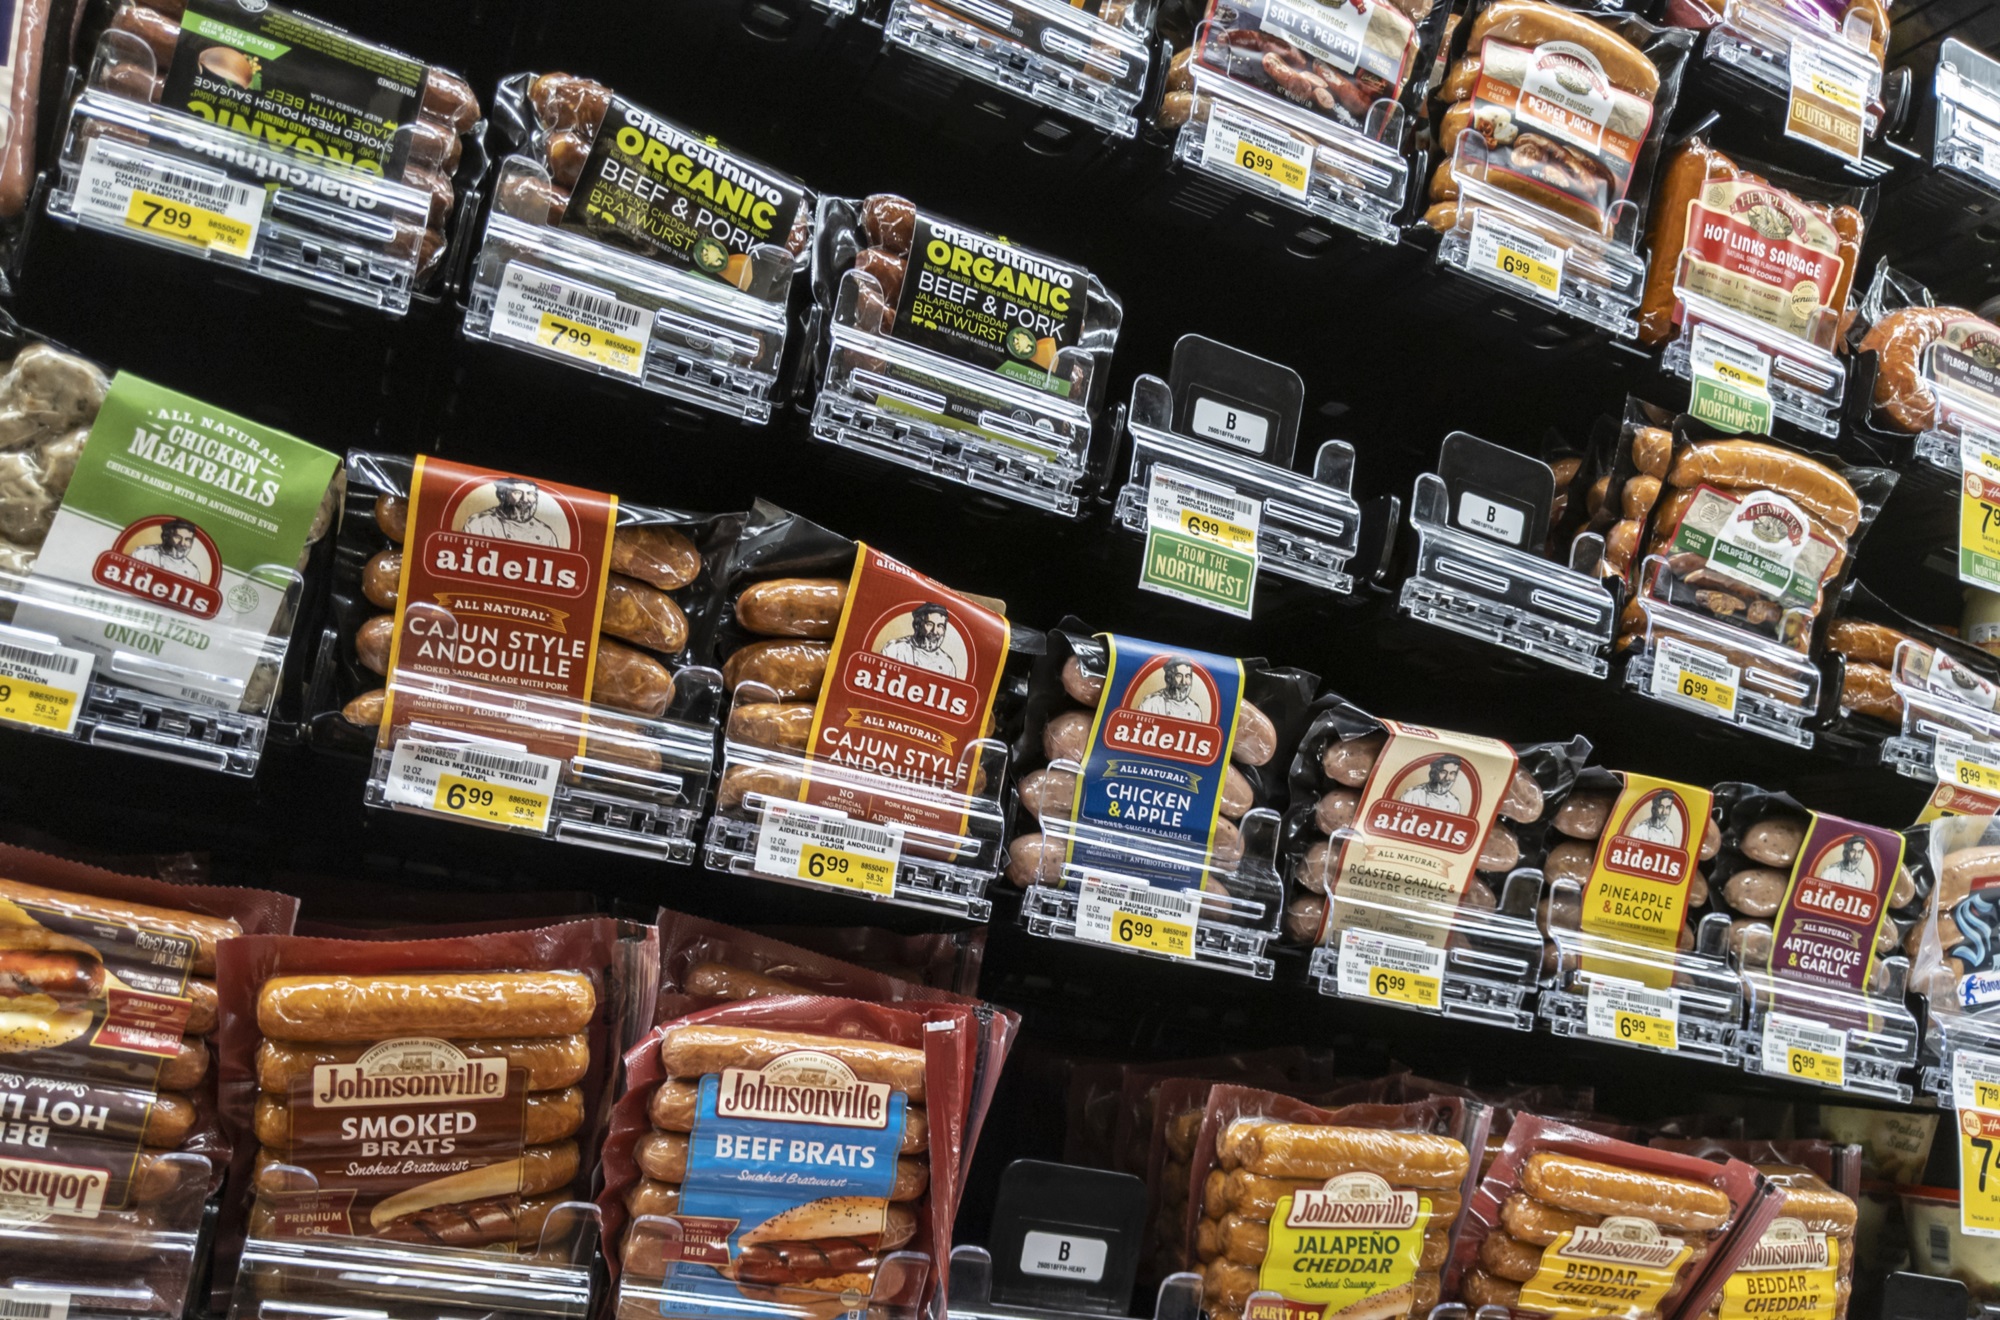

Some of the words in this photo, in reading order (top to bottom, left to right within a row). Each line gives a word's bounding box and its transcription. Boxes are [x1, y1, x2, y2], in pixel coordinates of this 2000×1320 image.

[1270, 5, 1298, 27] SALT
[1300, 20, 1309, 34] &
[1313, 26, 1355, 57] PEPPER
[194, 76, 252, 103] SAUSAGE
[1538, 85, 1565, 102] SMOKED
[1564, 98, 1594, 116] SAUSAGE
[255, 99, 300, 119] POLISH
[1528, 96, 1566, 122] PEPPER
[1568, 115, 1594, 136] JACK
[1795, 102, 1831, 130] GLUTEN
[1834, 119, 1856, 142] FREE
[302, 116, 341, 135] FRESH
[343, 130, 393, 152] SMOKED
[624, 108, 783, 206] charcutnuvo
[1242, 150, 1273, 171] 699
[115, 171, 184, 197] CHARCUTNUVO
[188, 190, 229, 209] SAUSAGE
[616, 126, 778, 231] ORGANIC
[115, 178, 148, 192] POLISH
[151, 189, 191, 204] SMOKED
[194, 201, 226, 215] ORGNC
[599, 157, 669, 203] BEEF
[670, 197, 688, 221] &
[695, 207, 766, 259] PORK
[142, 200, 192, 229] 799
[589, 188, 695, 252] BRATWURST
[929, 223, 1073, 289] charcutnuvo
[1504, 255, 1530, 274] 699
[1703, 222, 1731, 245] HOT
[1731, 230, 1766, 256] LINKS
[1769, 247, 1823, 280] SAUSAGE
[926, 239, 1071, 312] ORGANIC
[1738, 264, 1756, 274] FULLY
[1757, 270, 1782, 283] COOKED
[521, 293, 580, 316] CHARCUTNUVO
[582, 312, 629, 332] BRATWURST
[532, 304, 573, 321] JALAPENO
[575, 317, 597, 329] CHDR
[599, 324, 616, 334] ORG
[918, 270, 978, 303] BEEF
[982, 295, 997, 316] &
[1004, 301, 1066, 341] PORK
[550, 321, 592, 347] 799
[911, 301, 1007, 344] BRATWURST
[1969, 365, 1993, 383] SMOKED
[1713, 389, 1735, 404] FROM
[1738, 396, 1752, 411] THE
[1226, 412, 1237, 430] B
[1698, 398, 1764, 434] NORTHWEST
[157, 407, 195, 426] ALL
[199, 416, 281, 469] NATURAL
[167, 423, 262, 476] CHICKEN
[127, 428, 280, 508] MEATBALLS
[106, 459, 141, 483] CHICKEN
[141, 470, 173, 492] RAISED
[174, 483, 196, 500] WITH
[196, 491, 208, 505] NO
[207, 494, 257, 526] ANTIBIOTICS
[257, 513, 279, 534] EVER
[1968, 479, 1981, 492] SALE
[1176, 500, 1209, 515] ANDOUILLE
[1210, 509, 1235, 521] SMOKED
[1486, 505, 1496, 523] B
[437, 534, 462, 545] CHEF
[463, 537, 491, 549] BRUCE
[436, 546, 578, 590] aidells
[1176, 544, 1206, 564] FROM
[1209, 553, 1230, 572] THE
[102, 562, 211, 615] aidells
[1154, 555, 1244, 599] NORTHWEST
[103, 622, 166, 656] ONION
[408, 617, 499, 644] CAJUN
[508, 631, 586, 660] STYLE
[417, 639, 572, 680] ANDOUILLE
[413, 663, 450, 676] SMOKED
[450, 667, 491, 682] SAUSAGE
[491, 673, 519, 686] MADE
[520, 677, 544, 689] WITH
[545, 681, 569, 692] PORK
[1684, 679, 1708, 696] 699
[853, 667, 968, 717] aidells
[822, 726, 898, 761] CAJUN
[904, 750, 969, 780] STYLE
[1113, 721, 1211, 758] aidells
[402, 765, 410, 773] 12
[411, 767, 422, 775] OZ
[415, 754, 450, 767] AIDELLS
[452, 762, 495, 778] MEATBALL
[499, 771, 537, 786] TERIYAKI
[461, 771, 488, 782] PNAPL
[1960, 767, 1980, 784] 899
[447, 783, 494, 810] 699
[508, 795, 542, 809] 88650324
[826, 794, 862, 810] ARTIFICIAL
[838, 788, 855, 800] NO
[1105, 782, 1191, 812] CHICKEN
[903, 812, 917, 822] NO
[1108, 801, 1121, 817] &
[1124, 806, 1183, 828] APPLE
[778, 827, 809, 838] AIDELLS
[810, 832, 844, 845] SAUSAGE
[847, 840, 886, 854] ANDOUILLE
[778, 838, 786, 846] OZ
[1374, 812, 1468, 846] aidells
[820, 841, 845, 851] CAJUN
[809, 853, 849, 877] 699
[1610, 846, 1681, 877] aidells
[1097, 895, 1123, 905] AIDELLS
[1124, 901, 1152, 912] SAUSAGE
[1154, 908, 1182, 918] CHICKEN
[1599, 883, 1673, 910] PINEAPPLE
[1801, 887, 1872, 918] aidells
[1118, 907, 1138, 915] APPLE
[1140, 910, 1158, 919] SMKD
[1602, 900, 1612, 914] &
[1613, 901, 1664, 923] BACON
[1119, 919, 1153, 942] 699
[1355, 953, 1379, 961] AIDELLS
[1380, 957, 1404, 966] SAUSAGE
[1406, 962, 1430, 970] CHICKEN
[1782, 936, 1862, 966] ARTICHOKE
[1788, 952, 1797, 966] &
[1799, 956, 1850, 979] GARLIC
[1376, 974, 1405, 995] 699
[1620, 1017, 1646, 1037] 699
[1792, 1054, 1815, 1073] 699
[319, 1061, 499, 1104] Johnsonville
[724, 1071, 881, 1121] Johnsonville
[1979, 1086, 1999, 1105] 799
[29, 1097, 110, 1131] HOT
[341, 1111, 477, 1141] SMOKED
[1965, 1118, 1979, 1130] SALE
[361, 1136, 457, 1158] BRATS
[715, 1133, 784, 1161] BEEF
[788, 1143, 877, 1169] BRATS
[345, 1161, 401, 1177] Smoked
[401, 1159, 469, 1175] Bratwurst
[737, 1169, 785, 1185] Smoked
[786, 1172, 848, 1189] Bratwurst
[284, 1211, 343, 1224] PREMIUM
[1293, 1193, 1414, 1225] Johnsonville
[296, 1224, 331, 1237] PORK
[1294, 1231, 1400, 1255] JALAPEÑO
[684, 1246, 707, 1257] BEEF
[1057, 1240, 1071, 1263] B
[1566, 1230, 1676, 1265] Johnsonville
[1293, 1258, 1394, 1274] CHEDDAR
[1564, 1262, 1638, 1288] BEDDAR
[1304, 1277, 1341, 1290] Smoked
[1342, 1278, 1377, 1294] Sausage
[1552, 1280, 1643, 1300] CHEDDAR
[1746, 1274, 1809, 1296] BEDDAR
[1743, 1294, 1818, 1314] CHEDDAR
